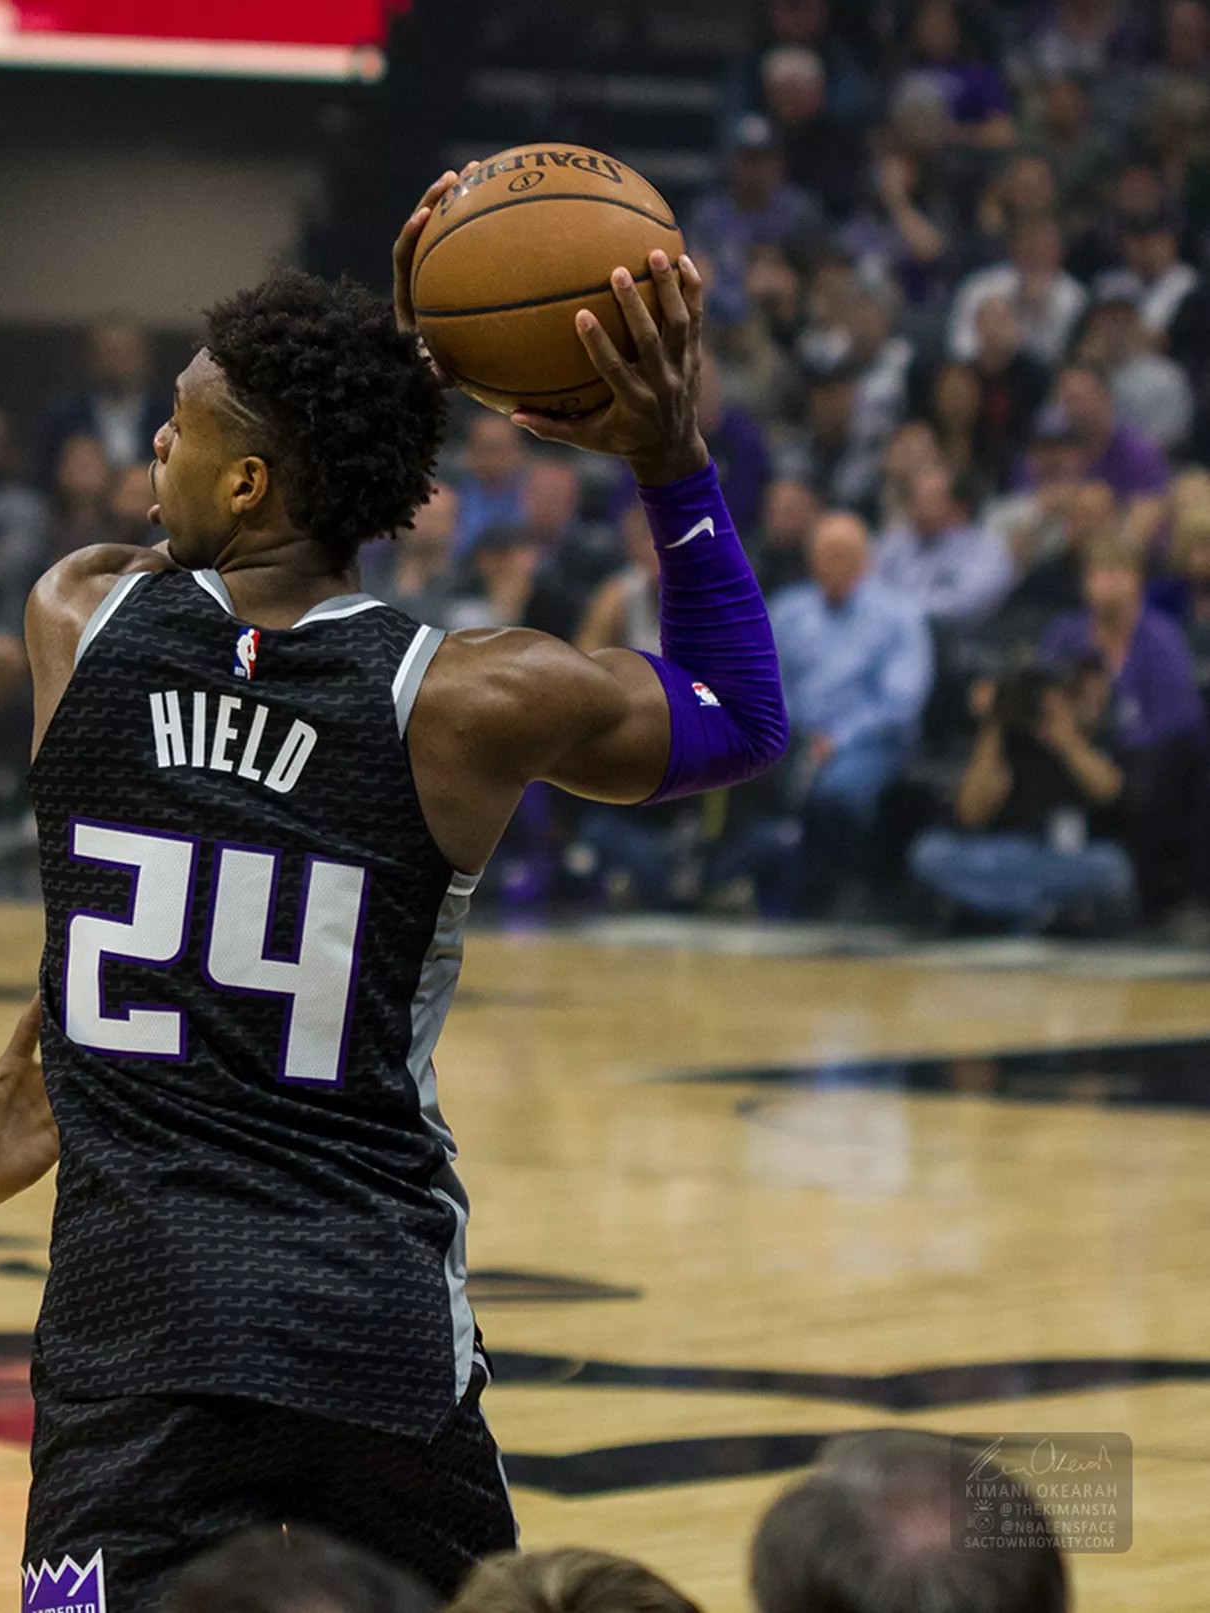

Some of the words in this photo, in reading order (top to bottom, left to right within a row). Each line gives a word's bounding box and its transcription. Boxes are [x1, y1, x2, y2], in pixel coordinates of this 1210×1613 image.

[440, 151, 623, 216] SPALDING
[148, 690, 318, 795] HIELD
[62, 816, 372, 1089] 24
